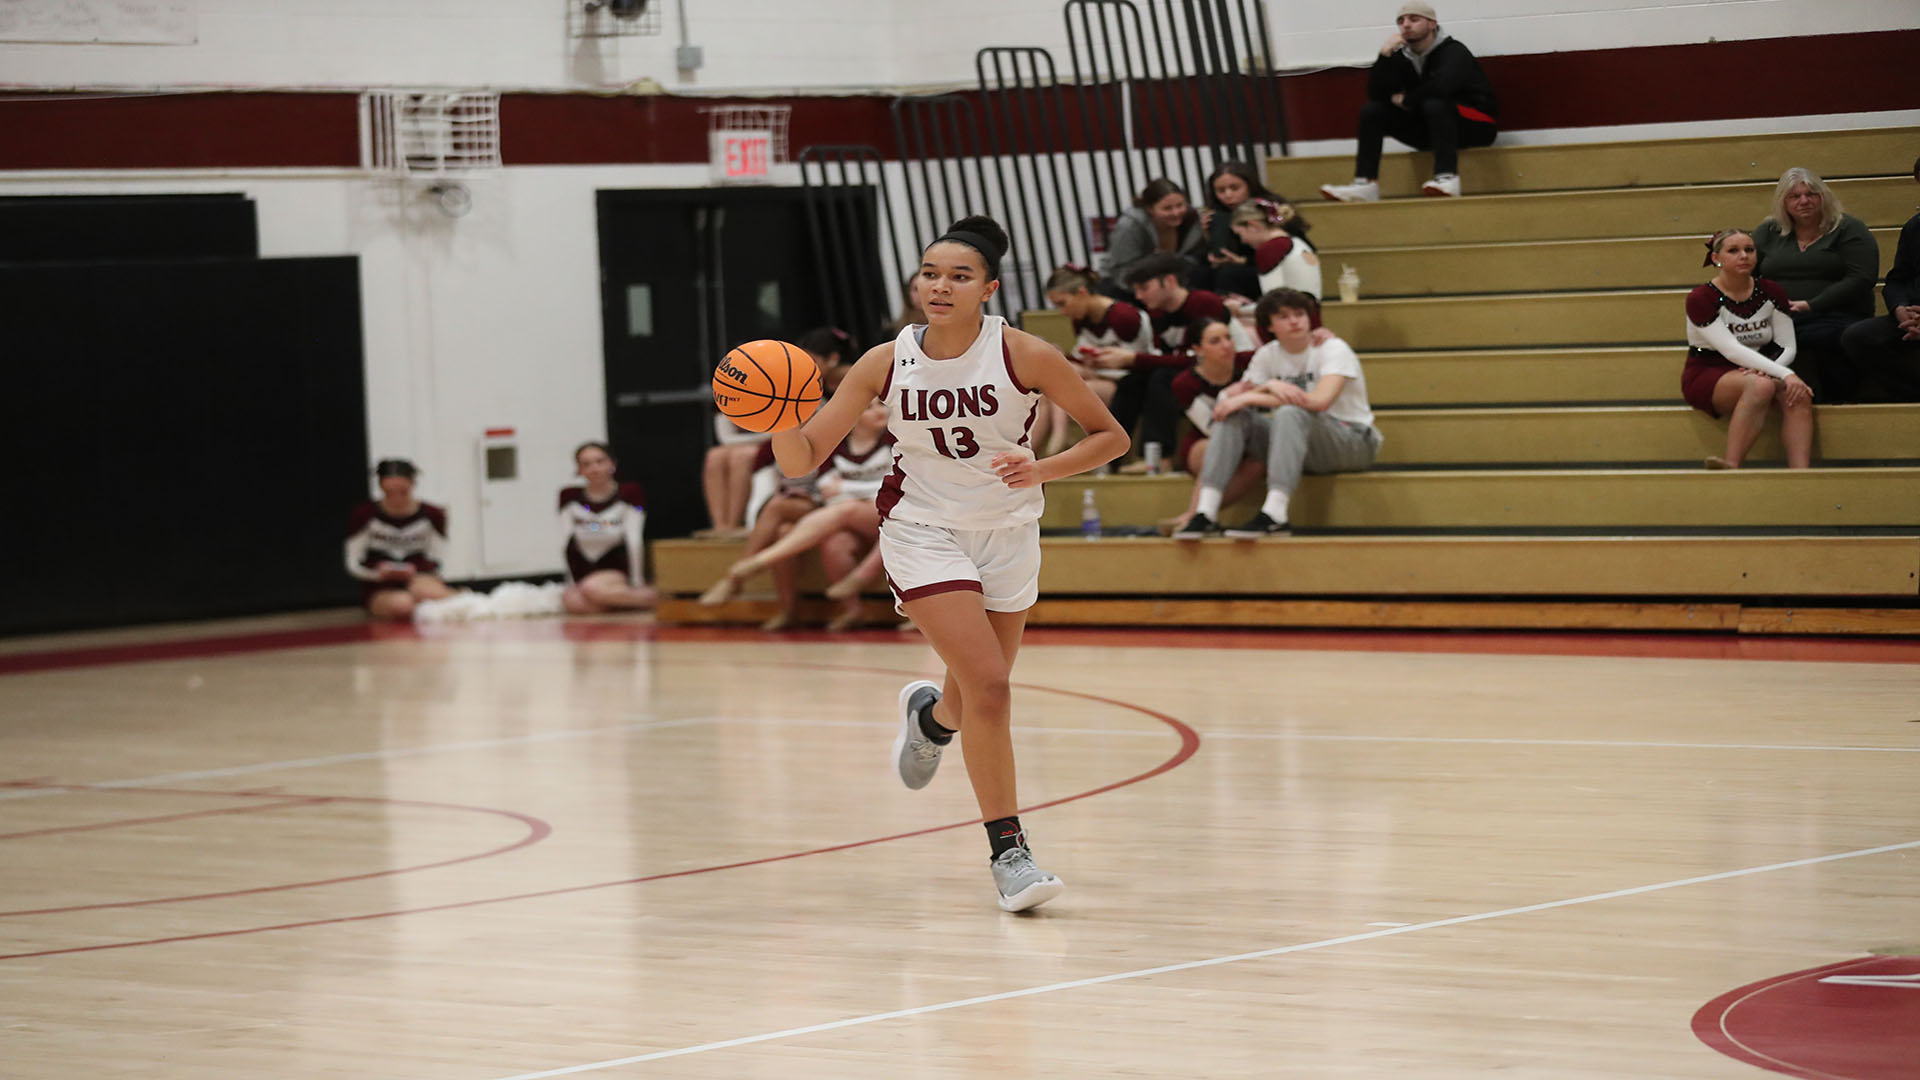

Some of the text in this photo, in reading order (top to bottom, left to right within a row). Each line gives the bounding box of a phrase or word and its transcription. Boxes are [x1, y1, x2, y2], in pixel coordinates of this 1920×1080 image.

[725, 138, 768, 176] EXIT
[900, 384, 999, 421] LIONS
[926, 426, 980, 460] 13
